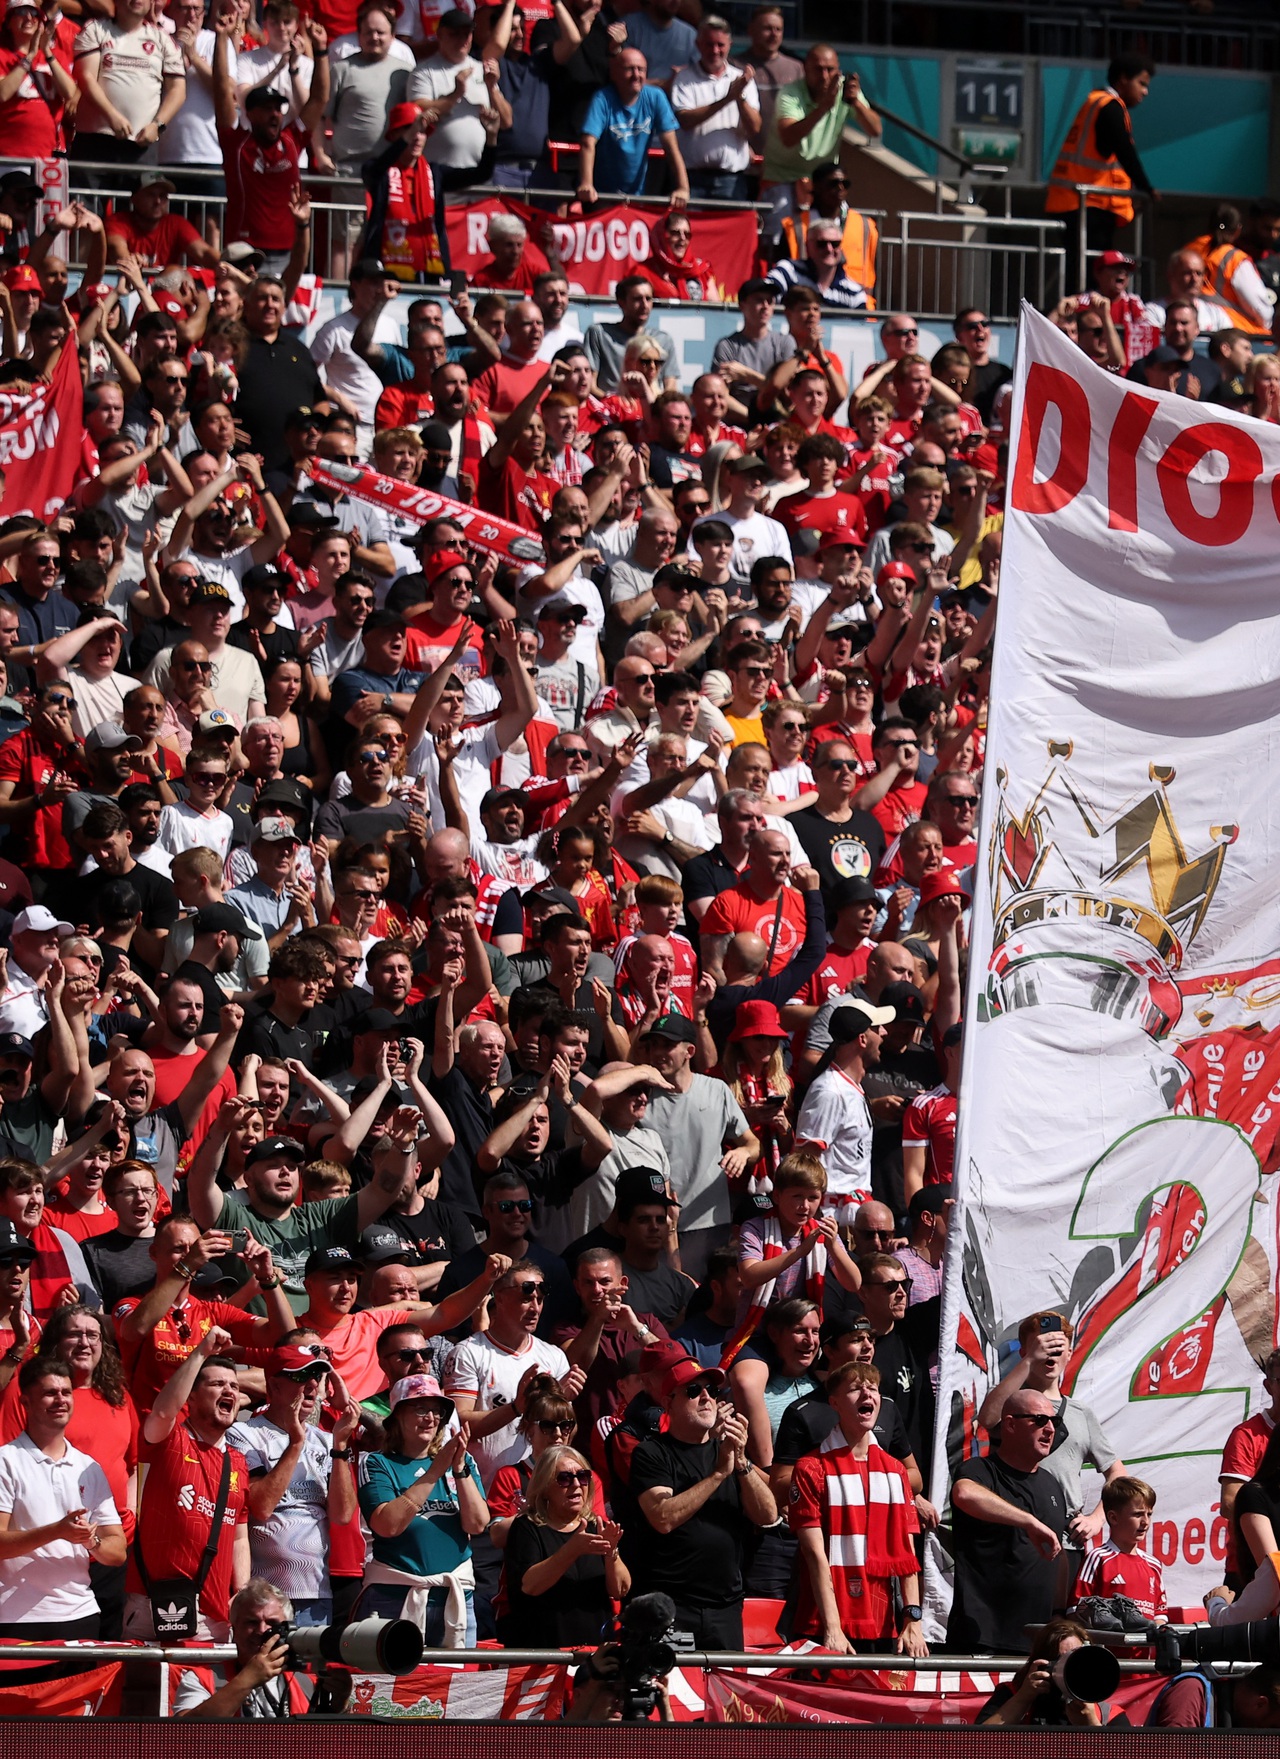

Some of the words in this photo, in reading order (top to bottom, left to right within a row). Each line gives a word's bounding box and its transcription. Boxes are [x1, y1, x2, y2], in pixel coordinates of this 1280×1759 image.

[962, 82, 1018, 116] 111
[553, 219, 651, 263] DIOGO
[375, 478, 395, 496] 20
[401, 489, 475, 531] JOTA
[477, 523, 499, 541] 20
[157, 1340, 198, 1353] Standar
[155, 1351, 188, 1363] Charte
[197, 1494, 237, 1516] stanard
[421, 1500, 457, 1512] rlsber
[157, 1621, 189, 1632] adidas
[742, 1703, 768, 1723] 97
